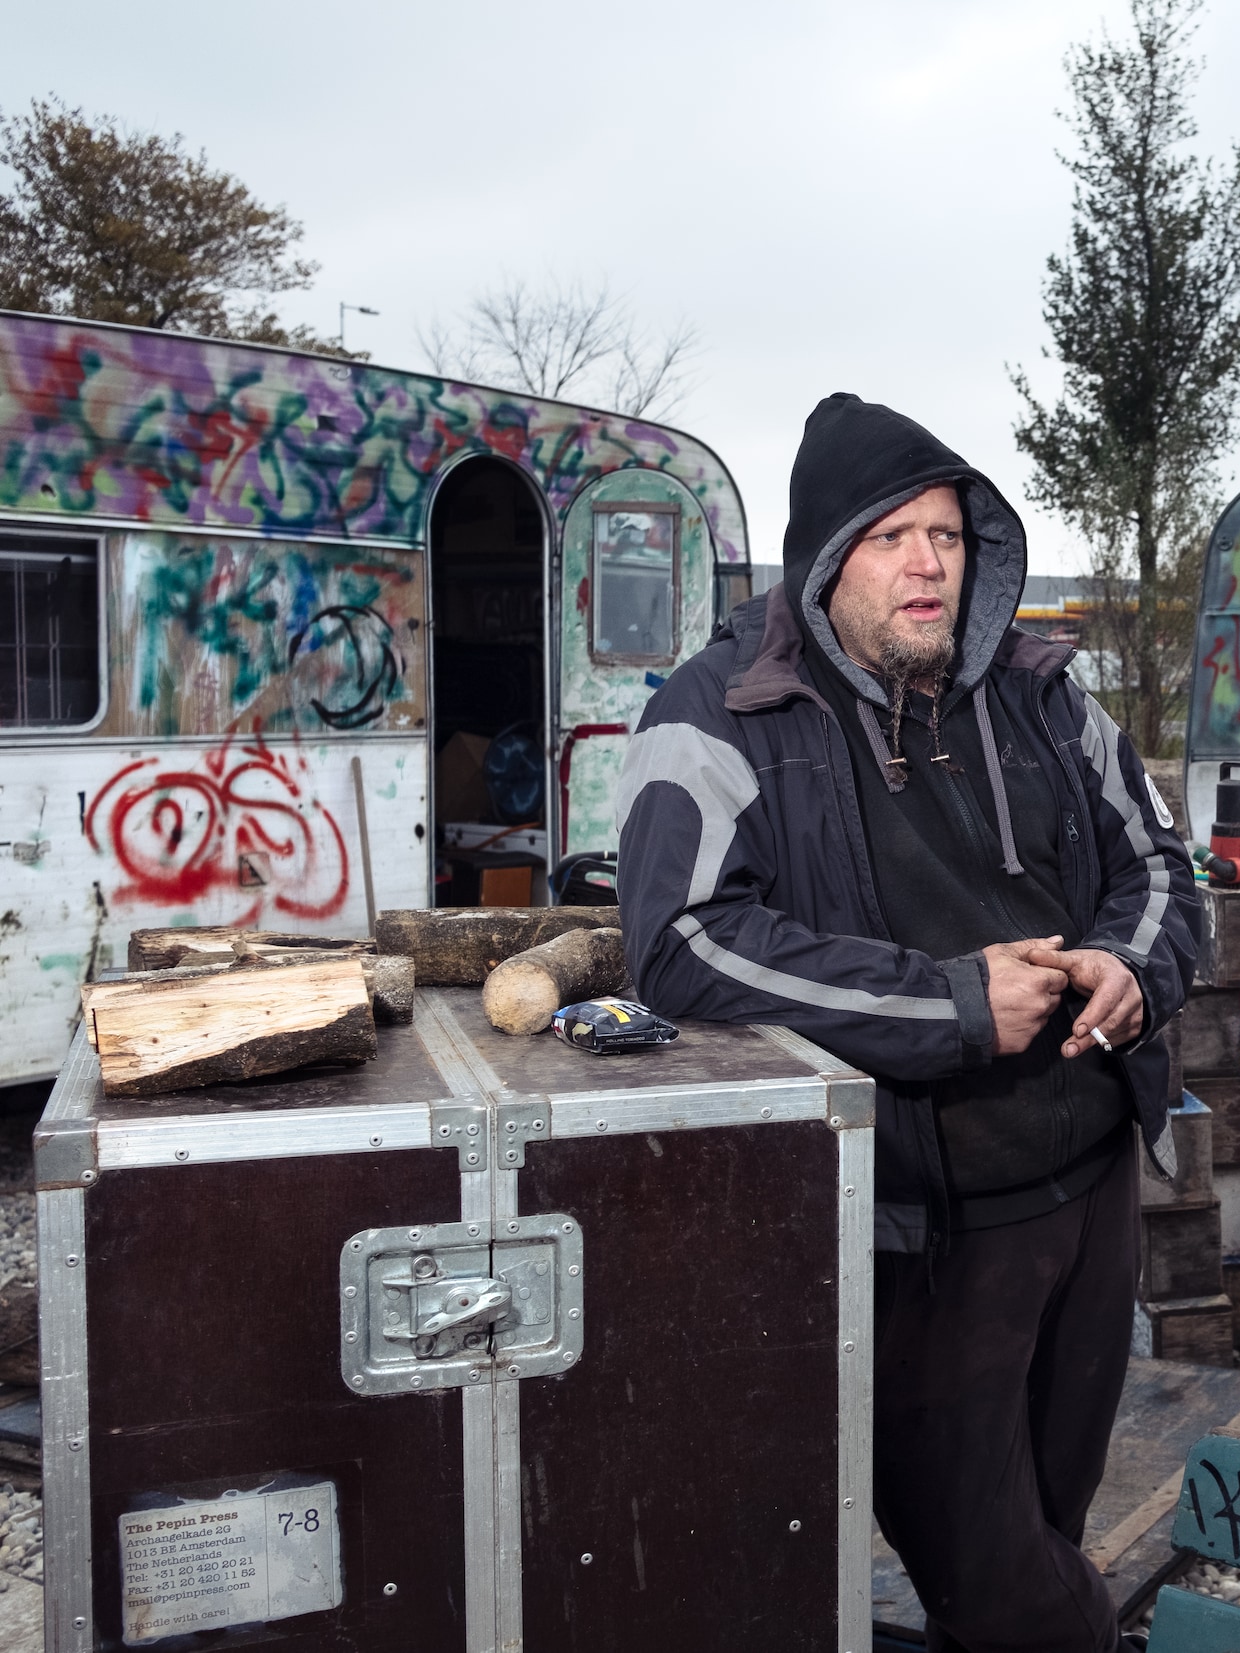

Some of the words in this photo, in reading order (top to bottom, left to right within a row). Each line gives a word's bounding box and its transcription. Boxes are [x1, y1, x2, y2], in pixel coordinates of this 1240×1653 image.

[126, 1524, 152, 1534] The
[156, 1517, 196, 1530] Pepin
[200, 1512, 238, 1524] Press
[278, 1509, 320, 1536] 7-8
[127, 1529, 212, 1547] Archangelkade
[216, 1525, 231, 1534] 2G
[128, 1548, 157, 1560] 1013
[161, 1545, 176, 1555] BE
[180, 1536, 246, 1551] Amsterdam
[127, 1562, 148, 1571] The
[152, 1550, 222, 1568] Netherlands
[127, 1574, 148, 1584] Tel:
[154, 1569, 174, 1579] +31
[179, 1566, 193, 1576] 20
[197, 1562, 218, 1573] 420
[222, 1559, 236, 1569] 20
[240, 1557, 253, 1566] 21
[128, 1586, 152, 1595] Fax:
[156, 1581, 176, 1590] +31
[180, 1578, 195, 1587] 20
[198, 1574, 220, 1584] 420
[225, 1571, 237, 1580] 11
[241, 1568, 256, 1577] 52
[128, 1582, 250, 1607] mail@pepinpress.com
[129, 1618, 170, 1631] Handle
[173, 1613, 198, 1624] with
[201, 1608, 230, 1619] care!
